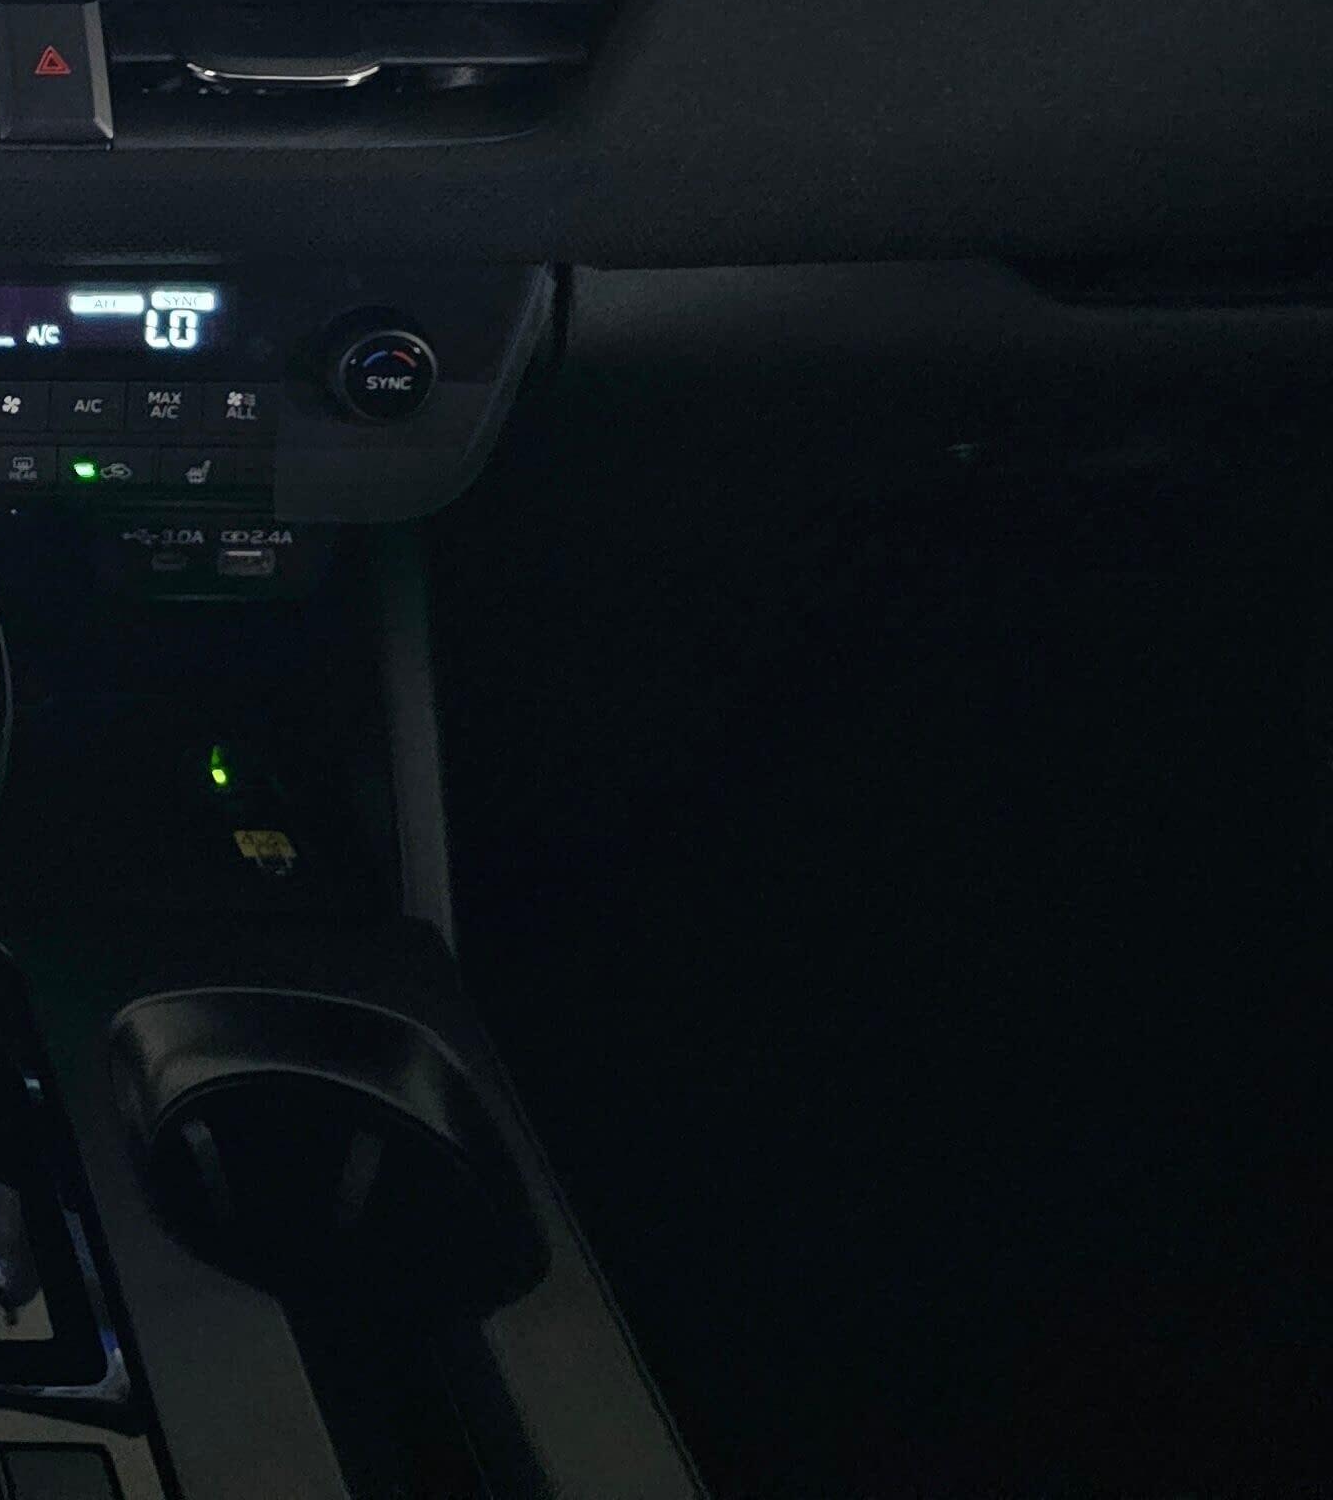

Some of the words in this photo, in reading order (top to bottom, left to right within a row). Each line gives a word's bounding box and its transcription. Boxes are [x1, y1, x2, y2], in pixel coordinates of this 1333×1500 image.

[365, 375, 414, 391] SYNC
[73, 398, 104, 414] A/C
[147, 391, 182, 405] MAX
[149, 405, 181, 420] A/C
[225, 405, 257, 421] ALL
[249, 529, 294, 545] 2.4A
